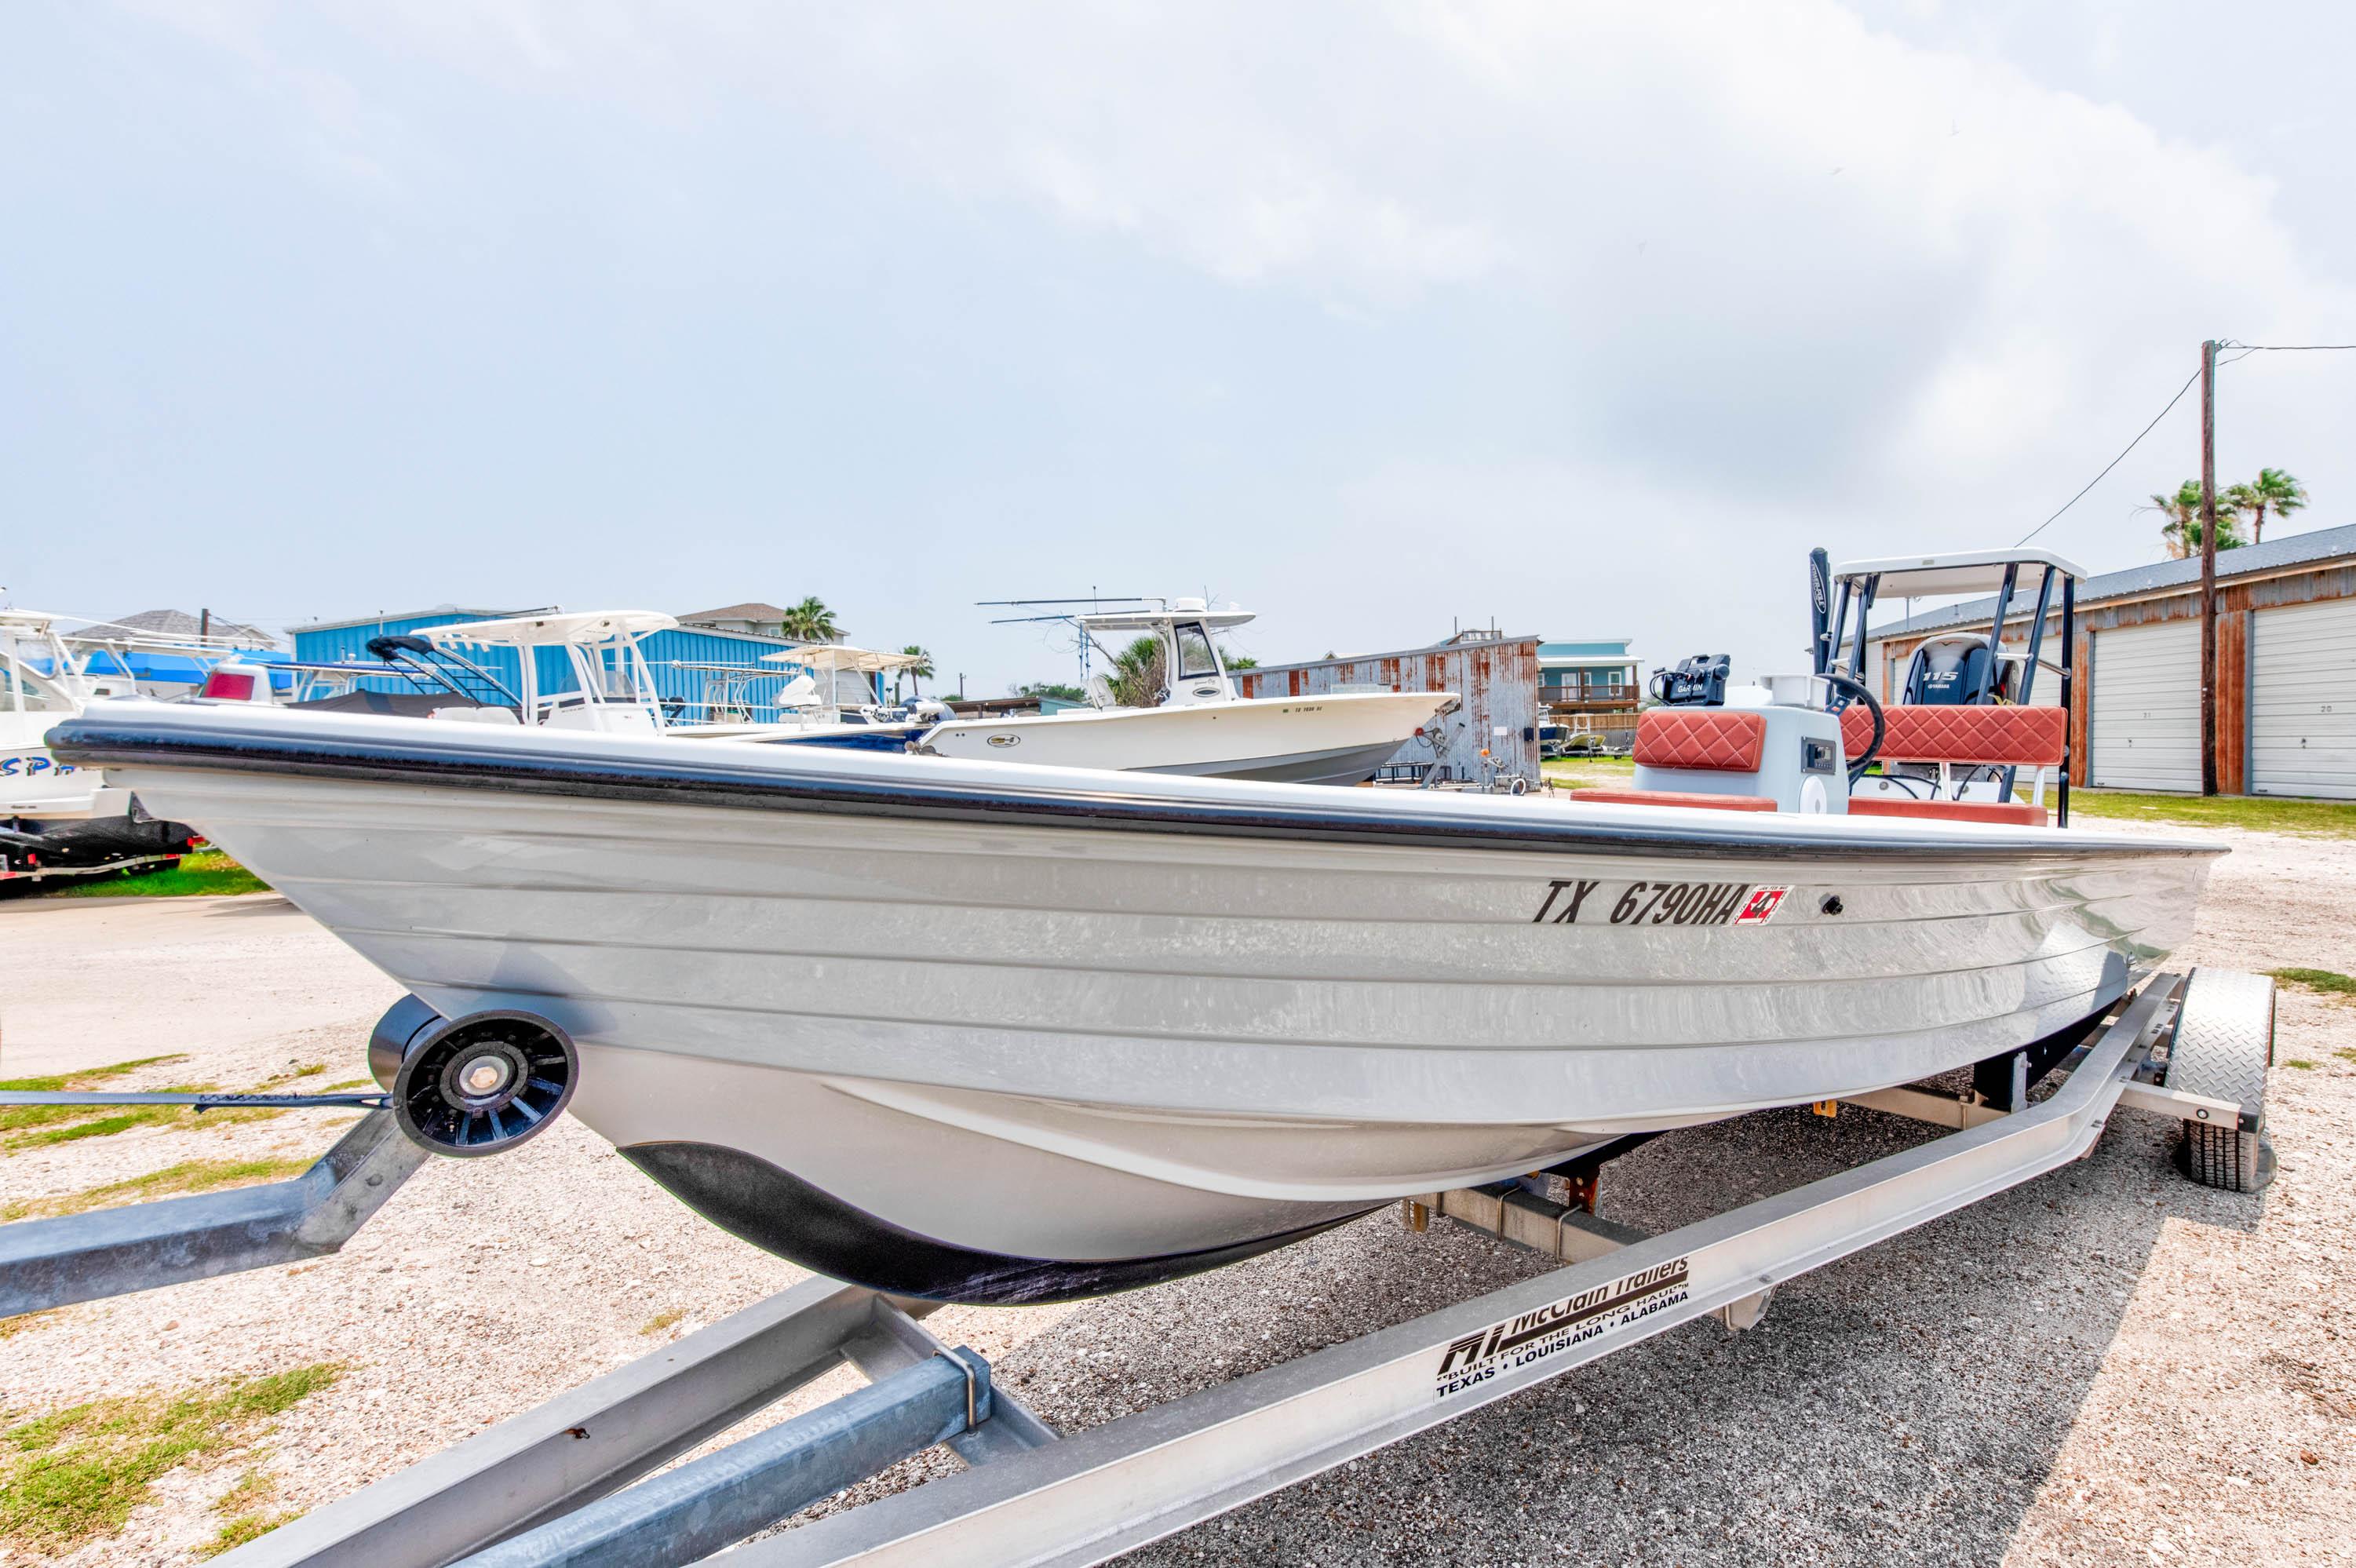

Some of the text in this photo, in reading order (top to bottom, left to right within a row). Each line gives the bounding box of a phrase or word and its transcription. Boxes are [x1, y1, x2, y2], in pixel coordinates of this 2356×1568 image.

[1923, 672, 1959, 681] 115
[1532, 880, 1600, 924] TX
[1610, 881, 1749, 924] 6790HA
[1751, 892, 1772, 919] 4
[1436, 1291, 1689, 1398] TEXAS LOUISIANA ALABAMA
[1501, 1342, 1534, 1361] FOR
[1539, 1328, 1569, 1344] THE
[1576, 1305, 1630, 1331] LONG
